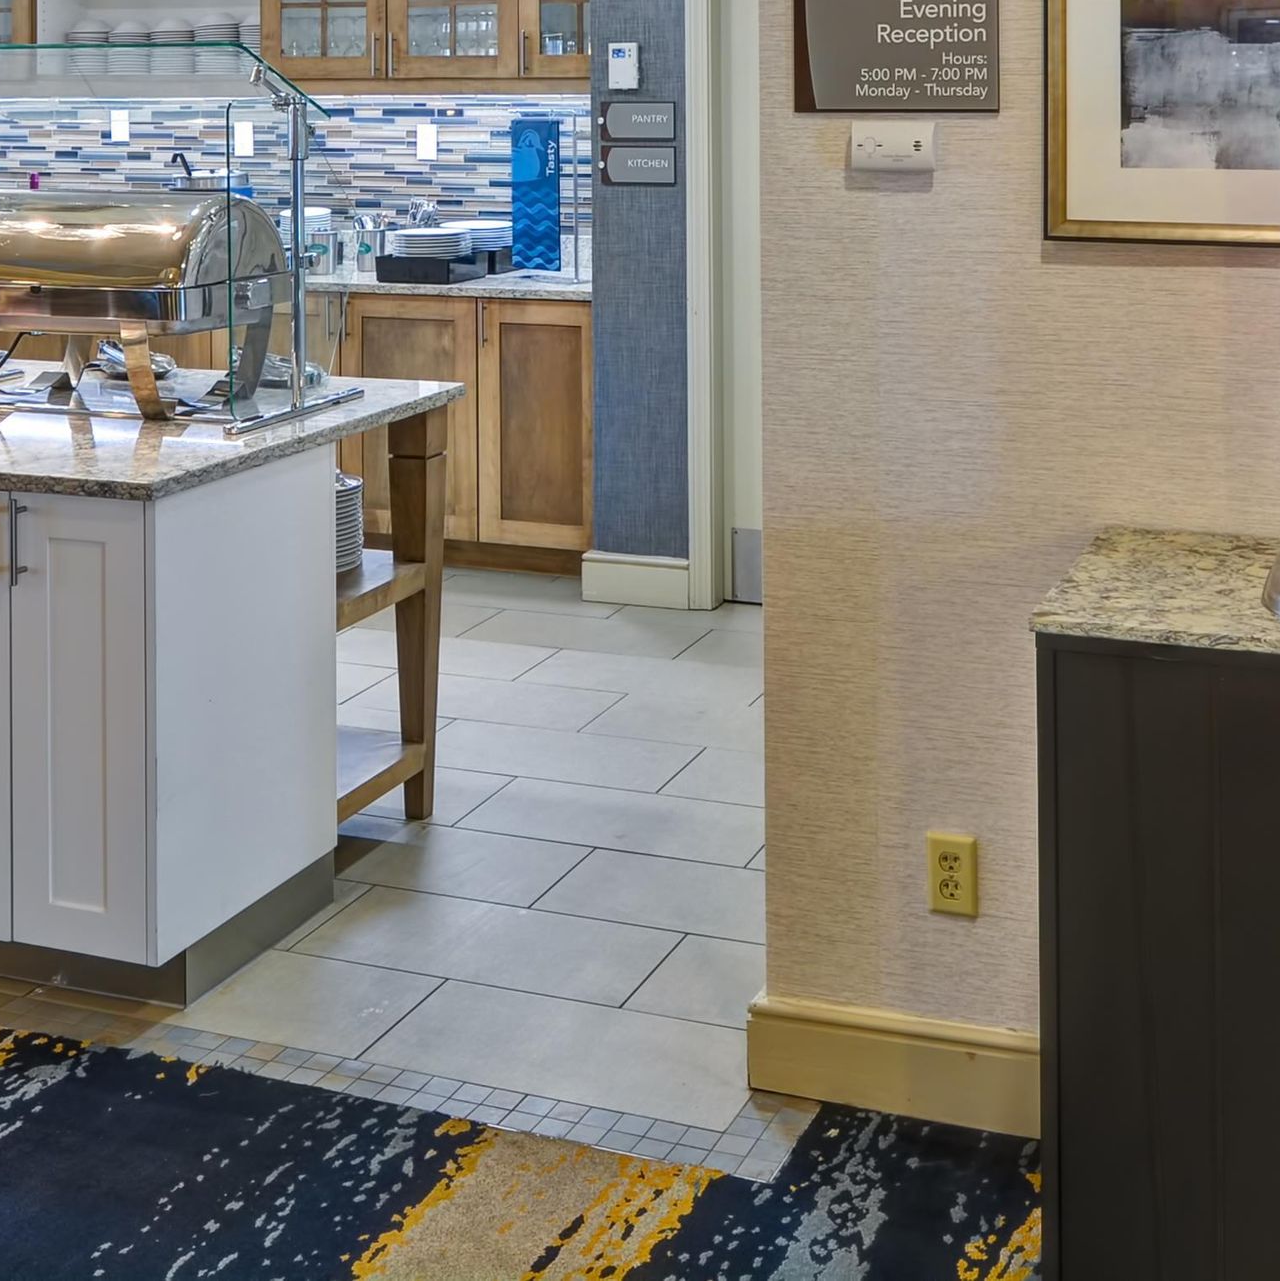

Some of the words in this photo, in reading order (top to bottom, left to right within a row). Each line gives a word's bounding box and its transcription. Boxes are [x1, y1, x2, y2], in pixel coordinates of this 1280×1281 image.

[877, 23, 987, 49] Reception
[942, 52, 988, 64] Hours:
[860, 68, 890, 81] 5:00
[894, 68, 917, 80] PM
[930, 68, 961, 80] 7:00
[964, 68, 988, 79] PM
[855, 83, 911, 99] Monday
[923, 83, 988, 99] Thursday
[631, 114, 668, 123] PANTRY
[546, 139, 557, 177] Tasty
[627, 159, 669, 168] KITCHEN
